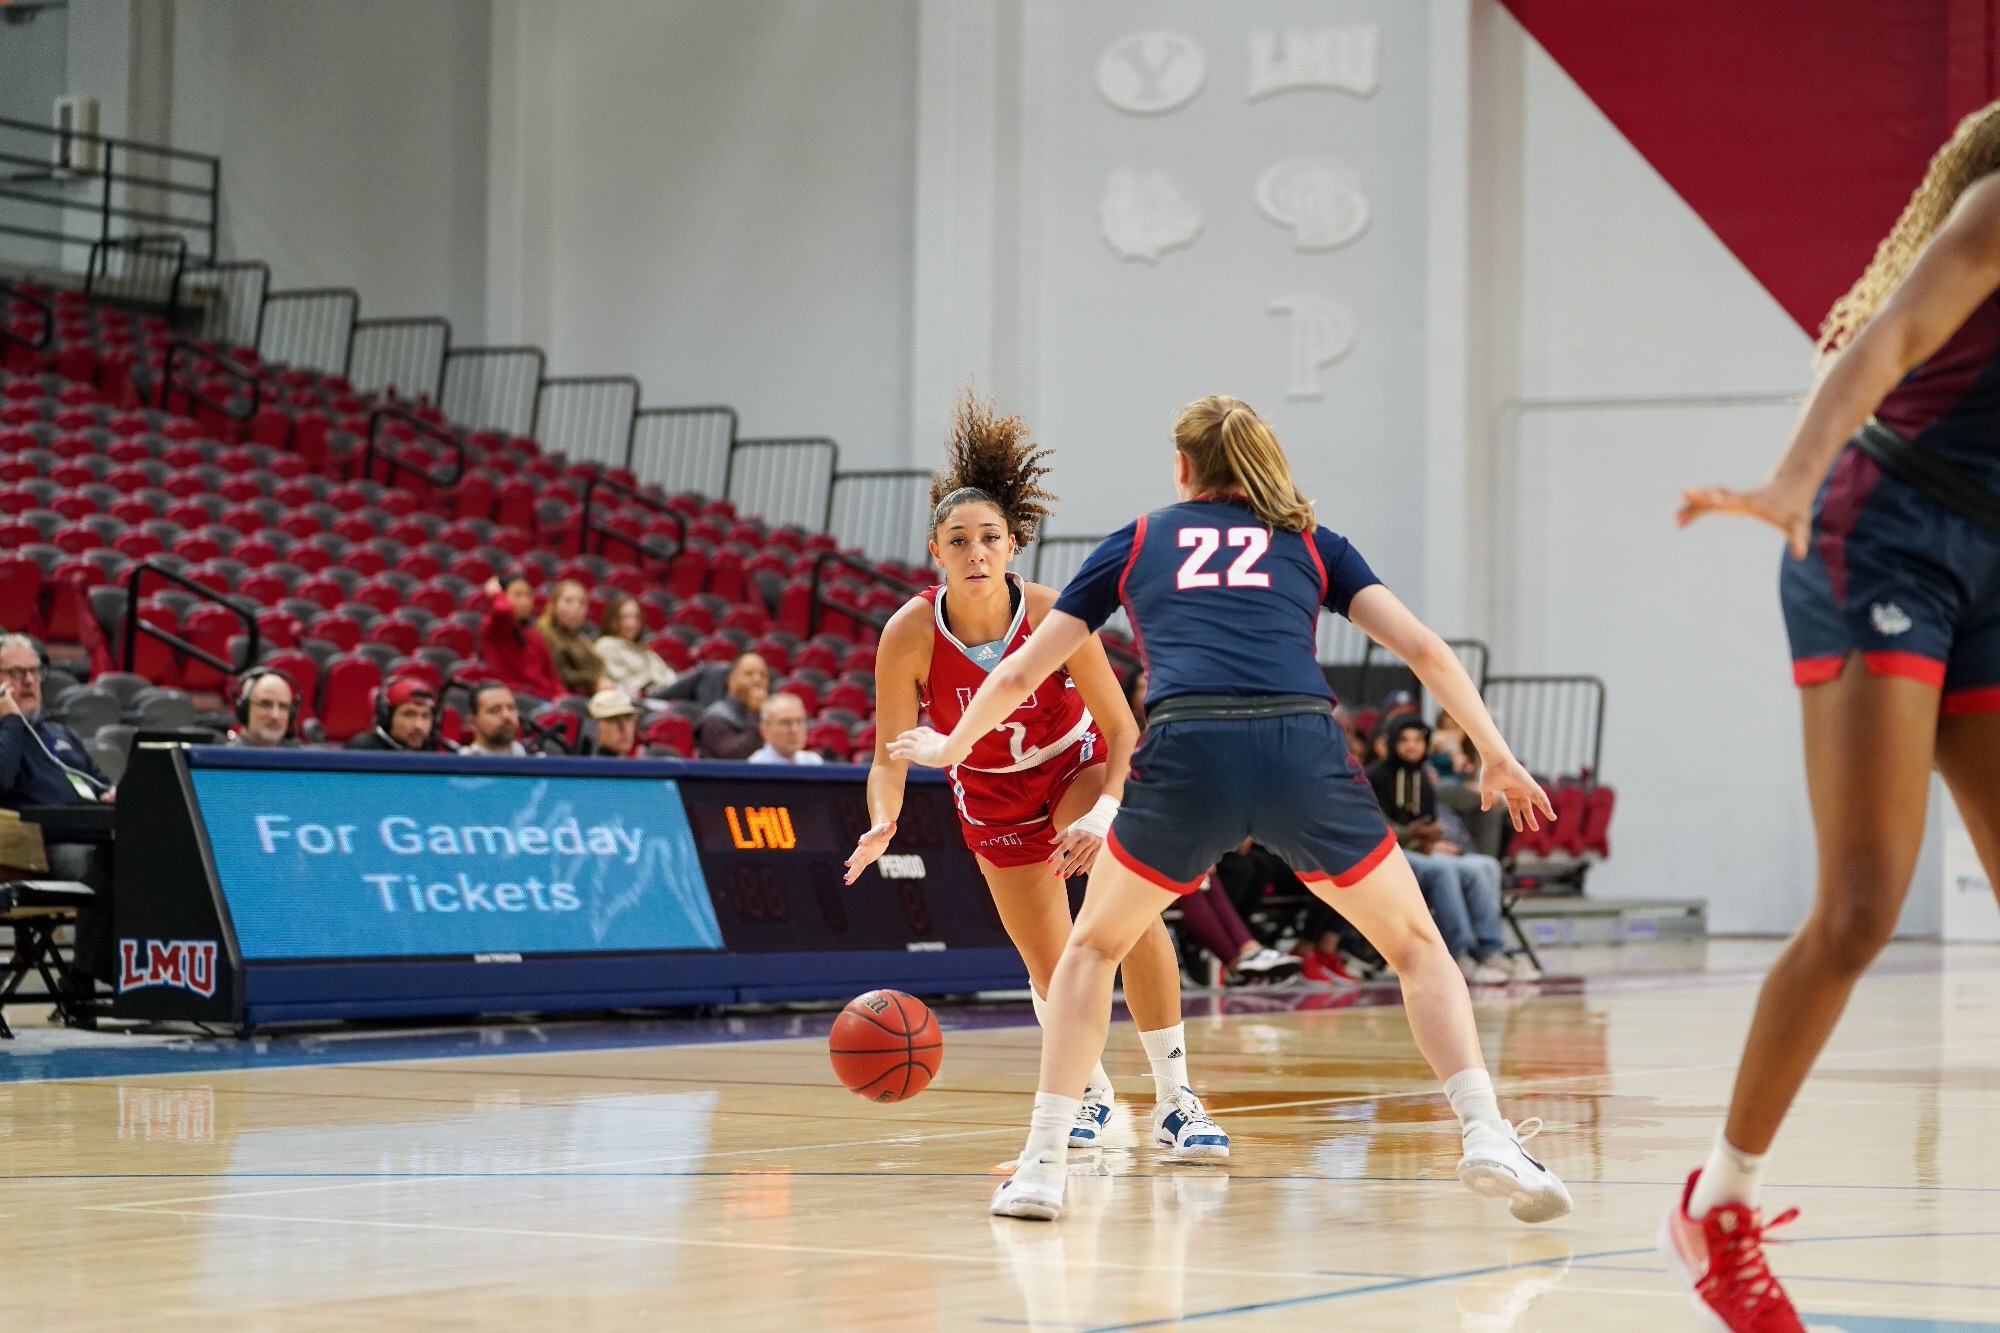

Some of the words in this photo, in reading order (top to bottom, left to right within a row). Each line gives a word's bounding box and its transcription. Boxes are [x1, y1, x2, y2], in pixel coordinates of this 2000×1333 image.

[1247, 24, 1380, 101] LMU
[1267, 294, 1356, 400] P
[1175, 525, 1272, 592] 22
[255, 814, 359, 856] For
[379, 815, 644, 865] Gameday
[724, 806, 796, 849] LMU
[363, 873, 582, 914] Tickets
[877, 854, 927, 879] PERIOD
[117, 938, 219, 998] LMU
